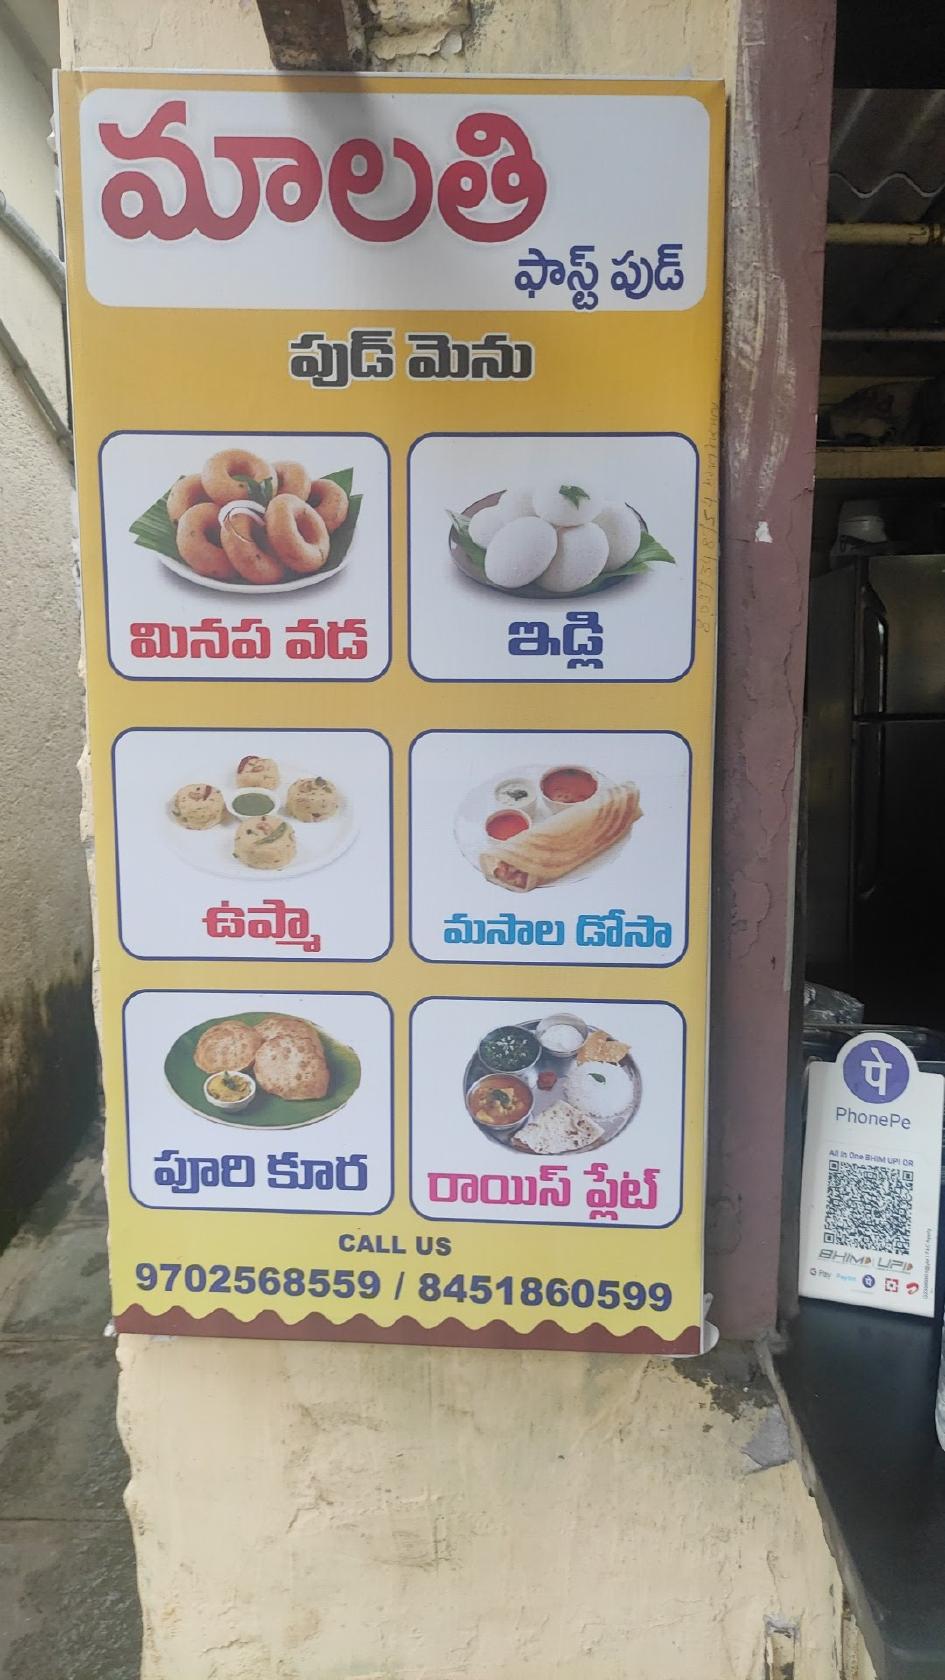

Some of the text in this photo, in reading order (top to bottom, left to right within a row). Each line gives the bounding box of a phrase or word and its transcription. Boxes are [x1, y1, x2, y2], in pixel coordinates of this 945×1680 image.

[98, 100, 548, 243] మాలతి
[514, 243, 684, 311] ఫాస్ట్ పుడ్
[289, 329, 533, 388] పుడ్ మెను
[130, 618, 368, 659] మినప వడ
[508, 611, 603, 669] ఇడ్లి
[202, 899, 321, 953] ఉప్మా
[443, 908, 672, 949] మసాల డోసా
[835, 1106, 911, 1130] PhonePe
[154, 1149, 368, 1193] పూరి కూర
[427, 1162, 661, 1221] రాయిస్ ప్లేట్
[338, 1234, 452, 1256] CALL US
[135, 1263, 673, 1312] 9702568559 / 8451860599
